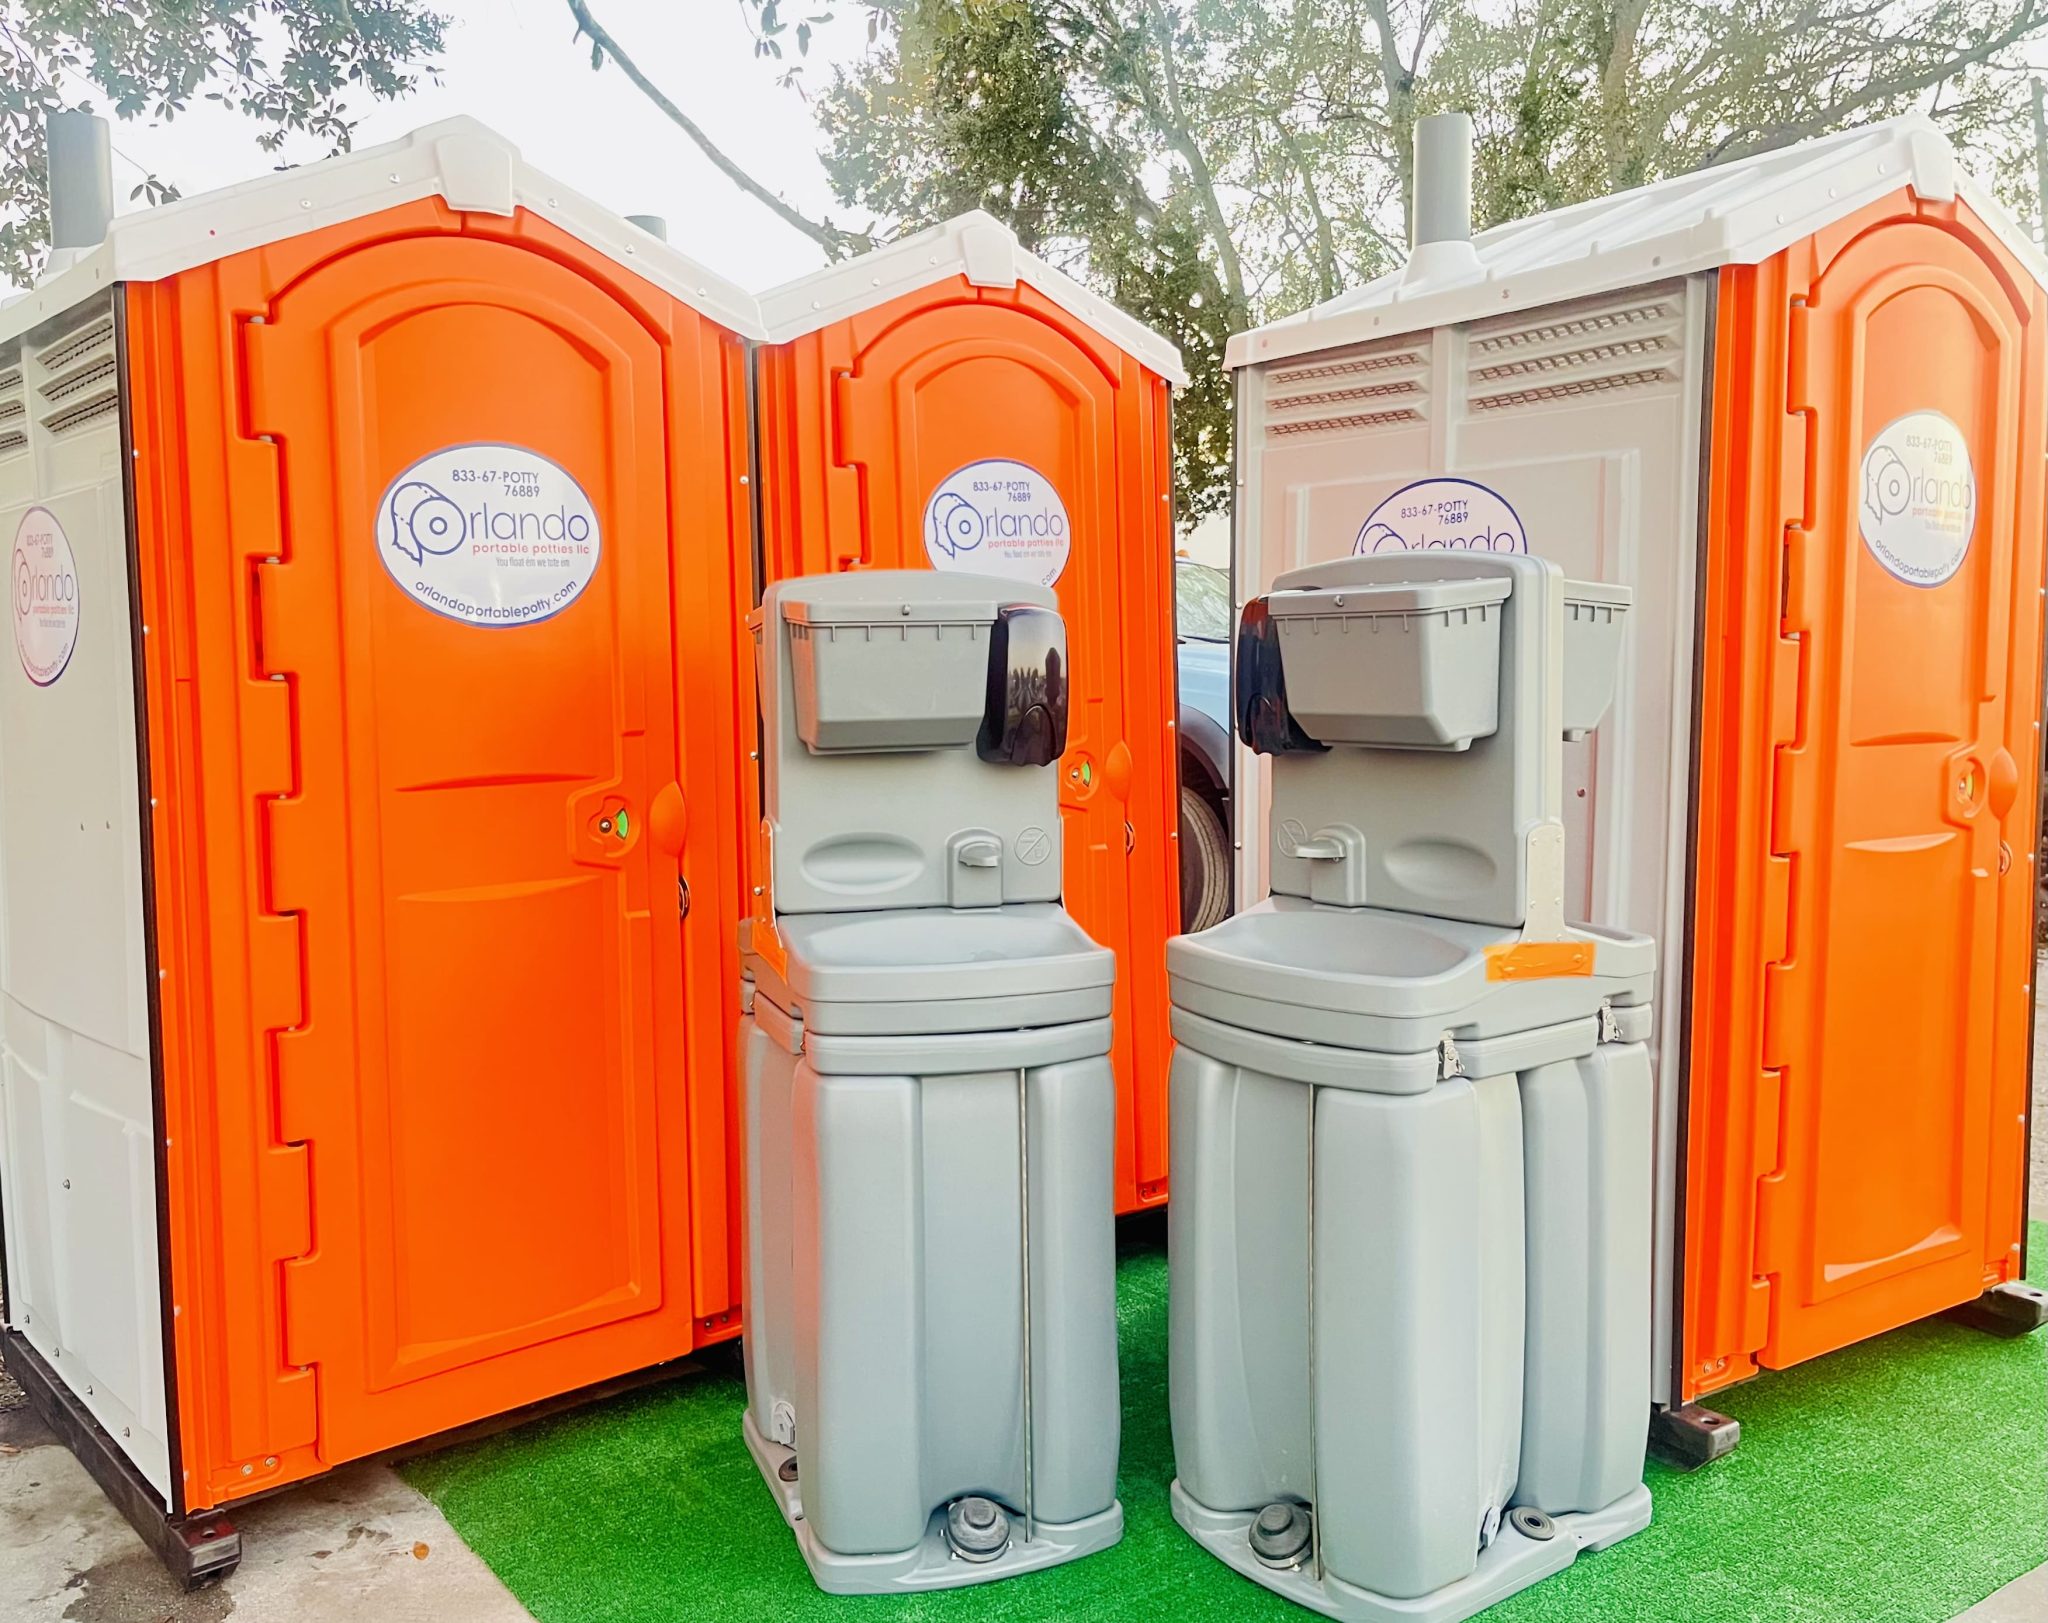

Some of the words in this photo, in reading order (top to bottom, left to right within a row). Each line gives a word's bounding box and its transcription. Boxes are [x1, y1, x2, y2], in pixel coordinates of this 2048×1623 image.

[452, 469, 540, 484] 833-67-POTTY
[503, 484, 540, 498] 76889
[973, 481, 1030, 492] 833-67-POTTY
[1007, 492, 1031, 502] 76889
[1401, 499, 1469, 519] 833-67-POTTY
[1438, 511, 1469, 526] 76889
[472, 544, 528, 555] portable
[532, 545, 573, 555] potties
[576, 544, 590, 554] llc
[1875, 539, 1962, 580] orlandoportablepottycom
[415, 579, 577, 619] orlandoportablepotty.com
